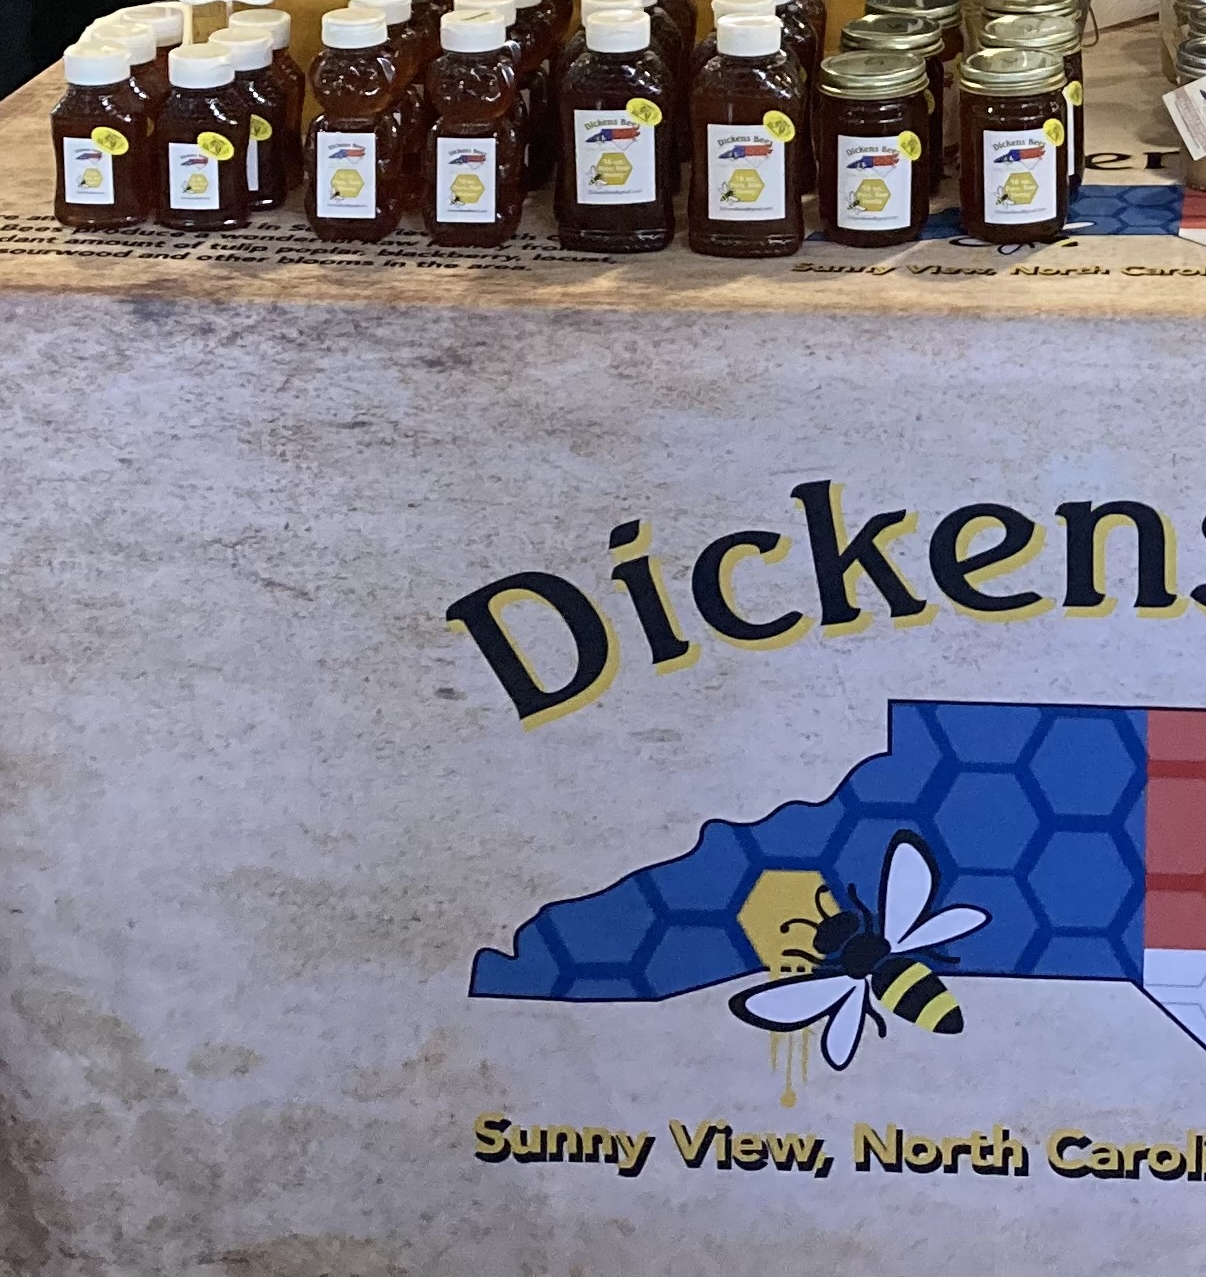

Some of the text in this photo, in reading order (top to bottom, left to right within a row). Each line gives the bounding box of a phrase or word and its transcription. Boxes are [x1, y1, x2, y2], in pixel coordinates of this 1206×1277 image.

[194, 231, 210, 239] a
[63, 238, 167, 249] amount
[172, 239, 205, 250] of
[209, 241, 269, 254] tulip
[377, 247, 522, 262] blackberry,
[521, 241, 564, 252] fro
[0, 246, 134, 259] sourwood
[138, 250, 191, 261] and
[195, 253, 270, 264] other
[276, 254, 375, 267] blooms
[382, 257, 407, 268] in
[416, 259, 460, 270] the
[791, 261, 899, 276] Sunny
[906, 263, 997, 277] View,
[1009, 264, 1111, 277] North
[473, 1112, 655, 1179] Sunny
[668, 1114, 834, 1183] View,
[852, 1118, 1030, 1180] North
